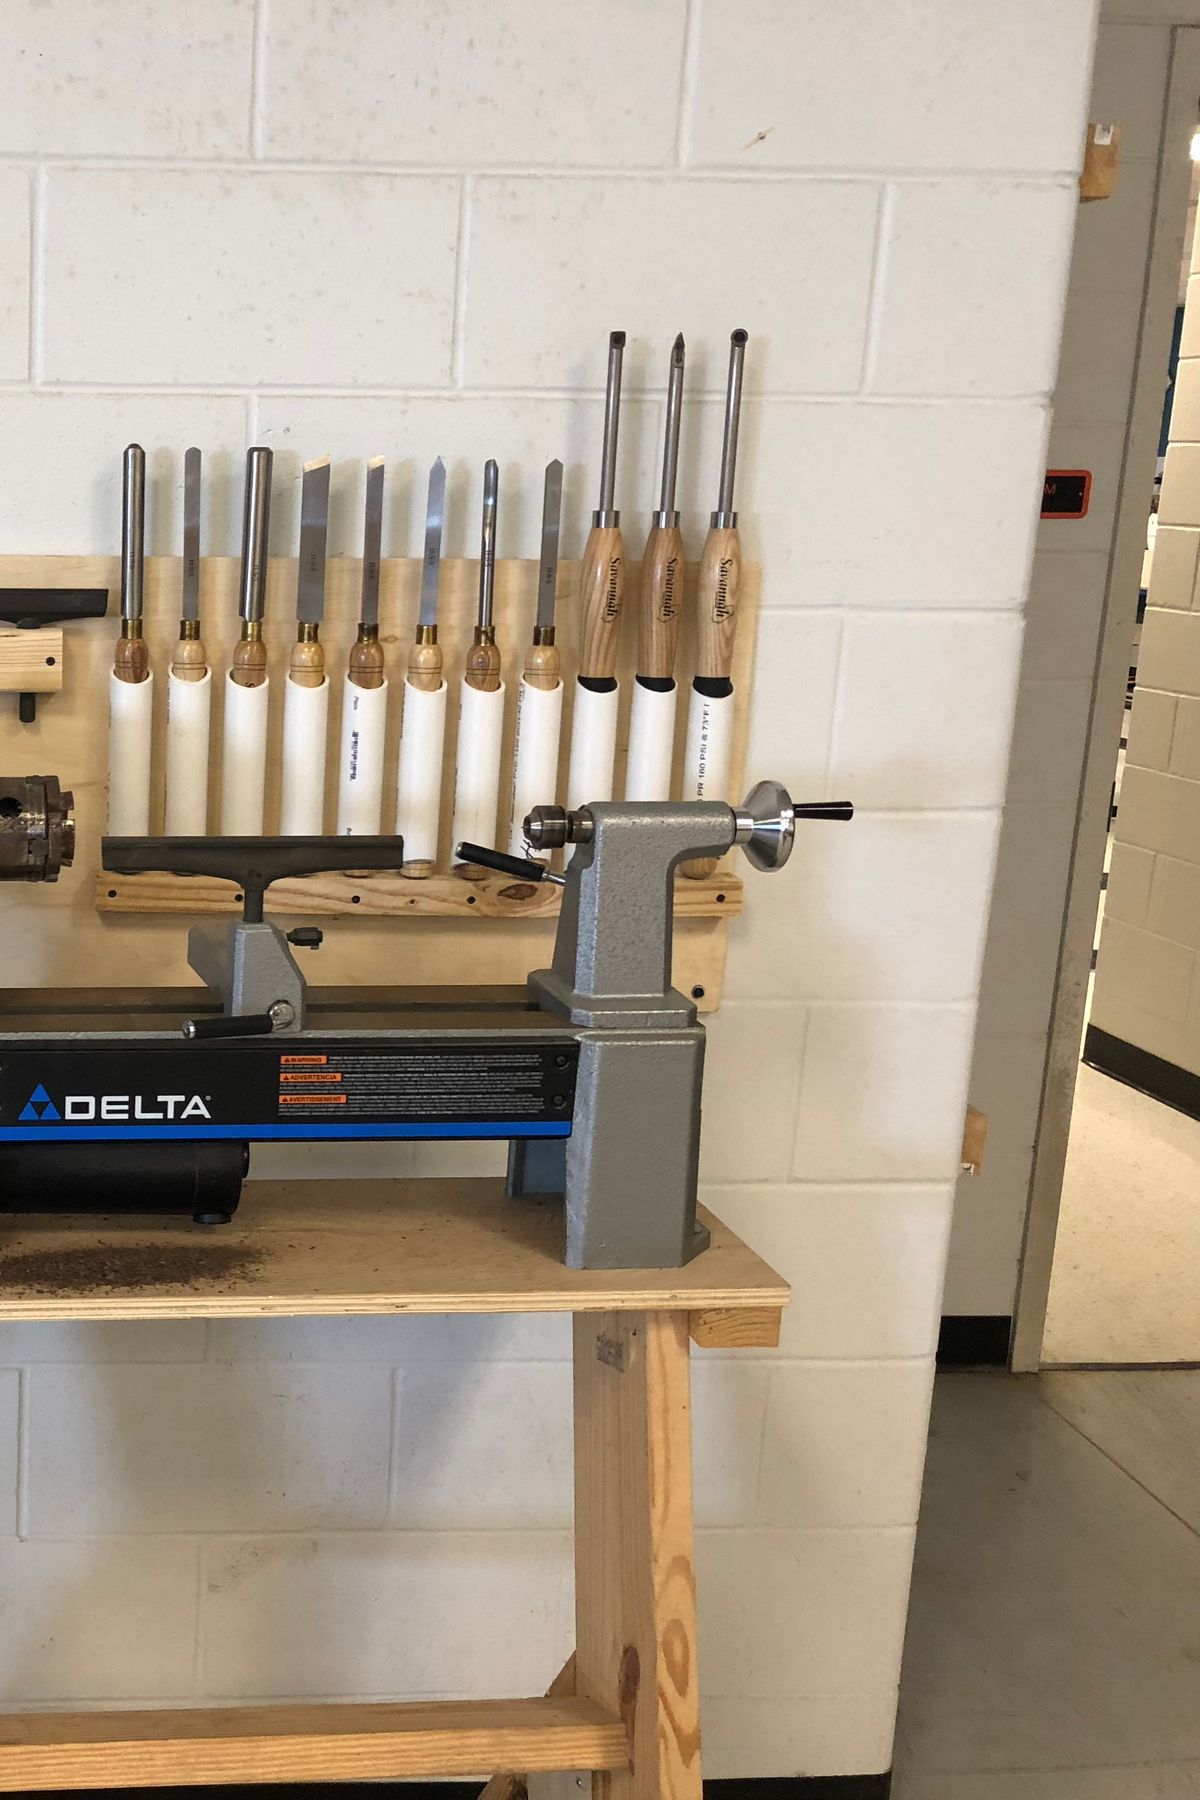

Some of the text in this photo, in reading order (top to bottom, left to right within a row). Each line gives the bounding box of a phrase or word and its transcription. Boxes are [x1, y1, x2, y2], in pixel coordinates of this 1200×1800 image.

[607, 556, 621, 616] Savannah
[663, 557, 678, 617] Savannah
[715, 557, 733, 618] Savannah
[64, 1095, 212, 1120] DELTA
